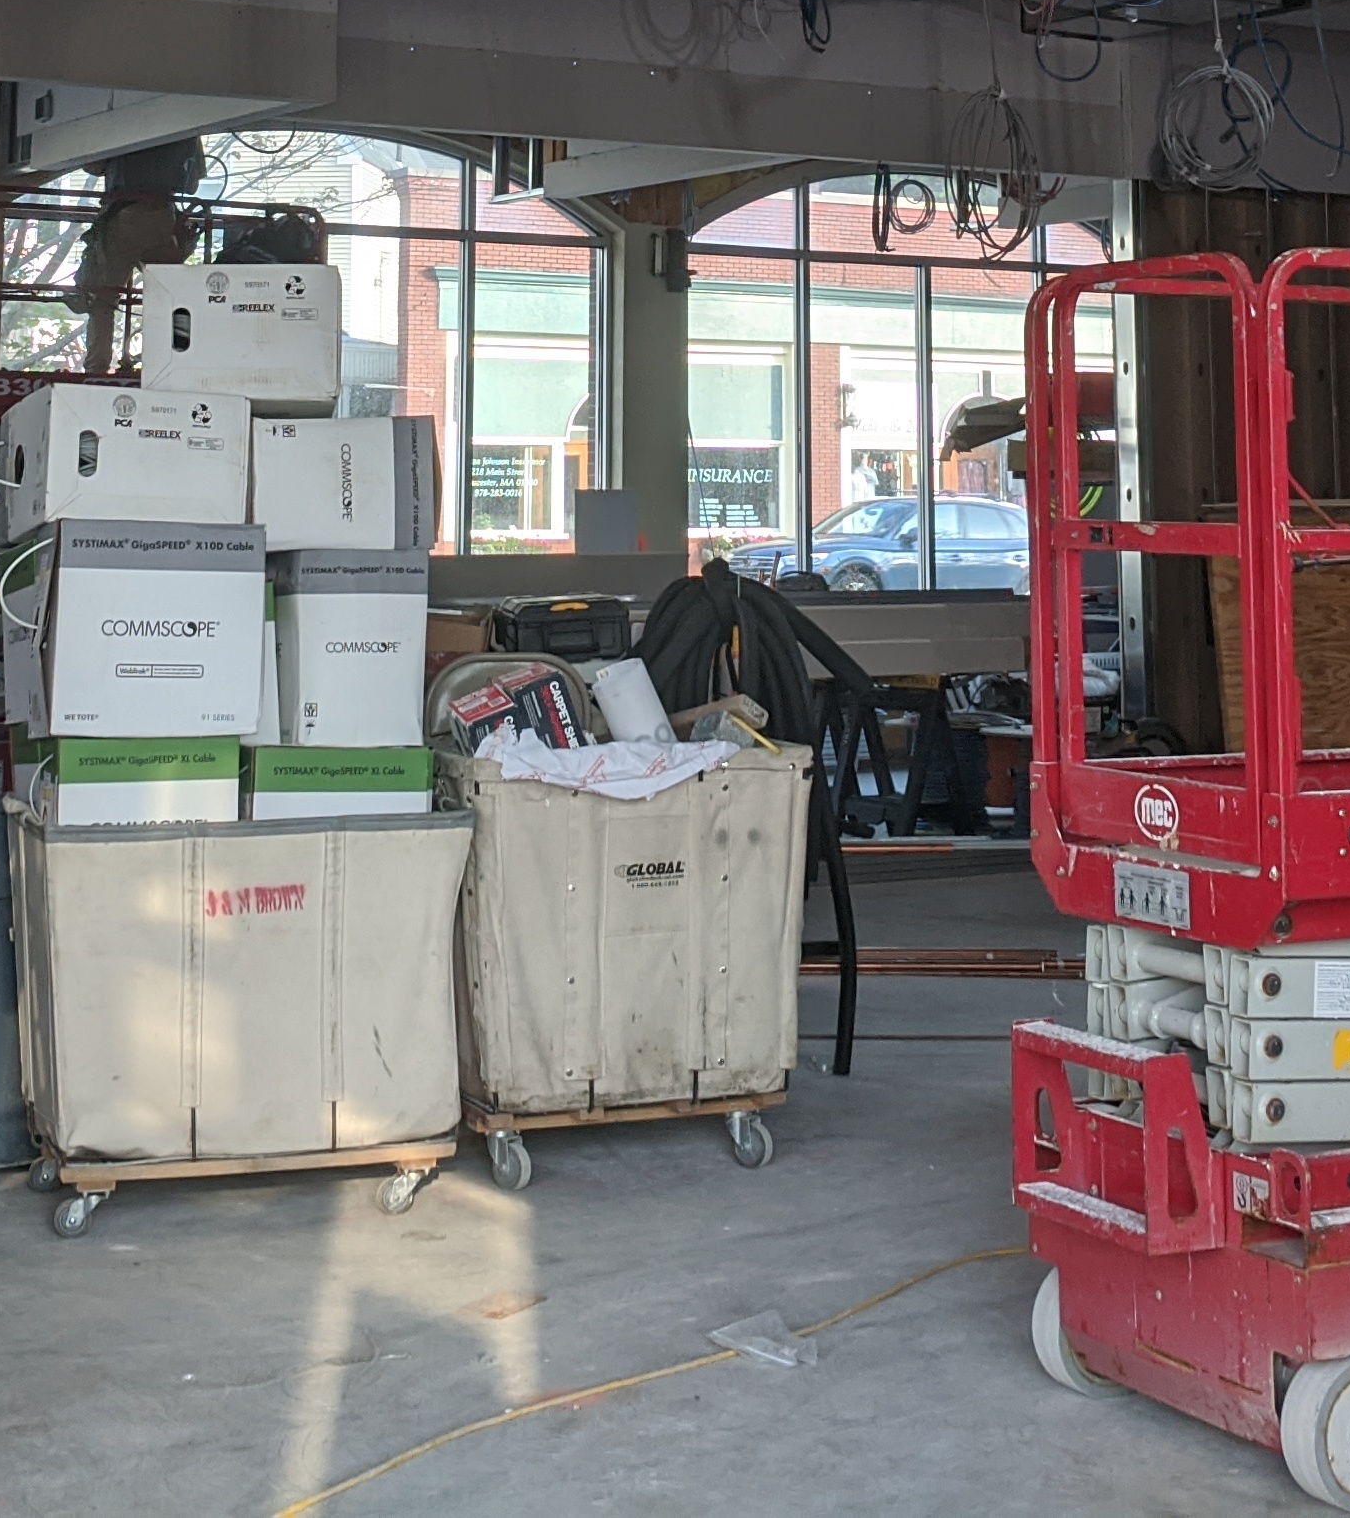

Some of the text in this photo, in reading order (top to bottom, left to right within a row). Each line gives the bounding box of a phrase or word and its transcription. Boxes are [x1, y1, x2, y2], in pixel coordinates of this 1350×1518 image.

[114, 418, 132, 428] PCA
[341, 443, 352, 520] COMMSCOPE
[687, 467, 773, 483] INSURANCE
[195, 541, 224, 551] X10D
[226, 541, 255, 552] Cable
[101, 619, 217, 638] COMMSCOPE
[325, 641, 399, 653] COMMSCOPE
[549, 680, 572, 727] CARPET
[212, 714, 235, 722] SERIES
[192, 753, 216, 764] Cable
[382, 766, 406, 775] Cable
[1141, 797, 1173, 828] mec
[627, 861, 685, 876] GLOBAL
